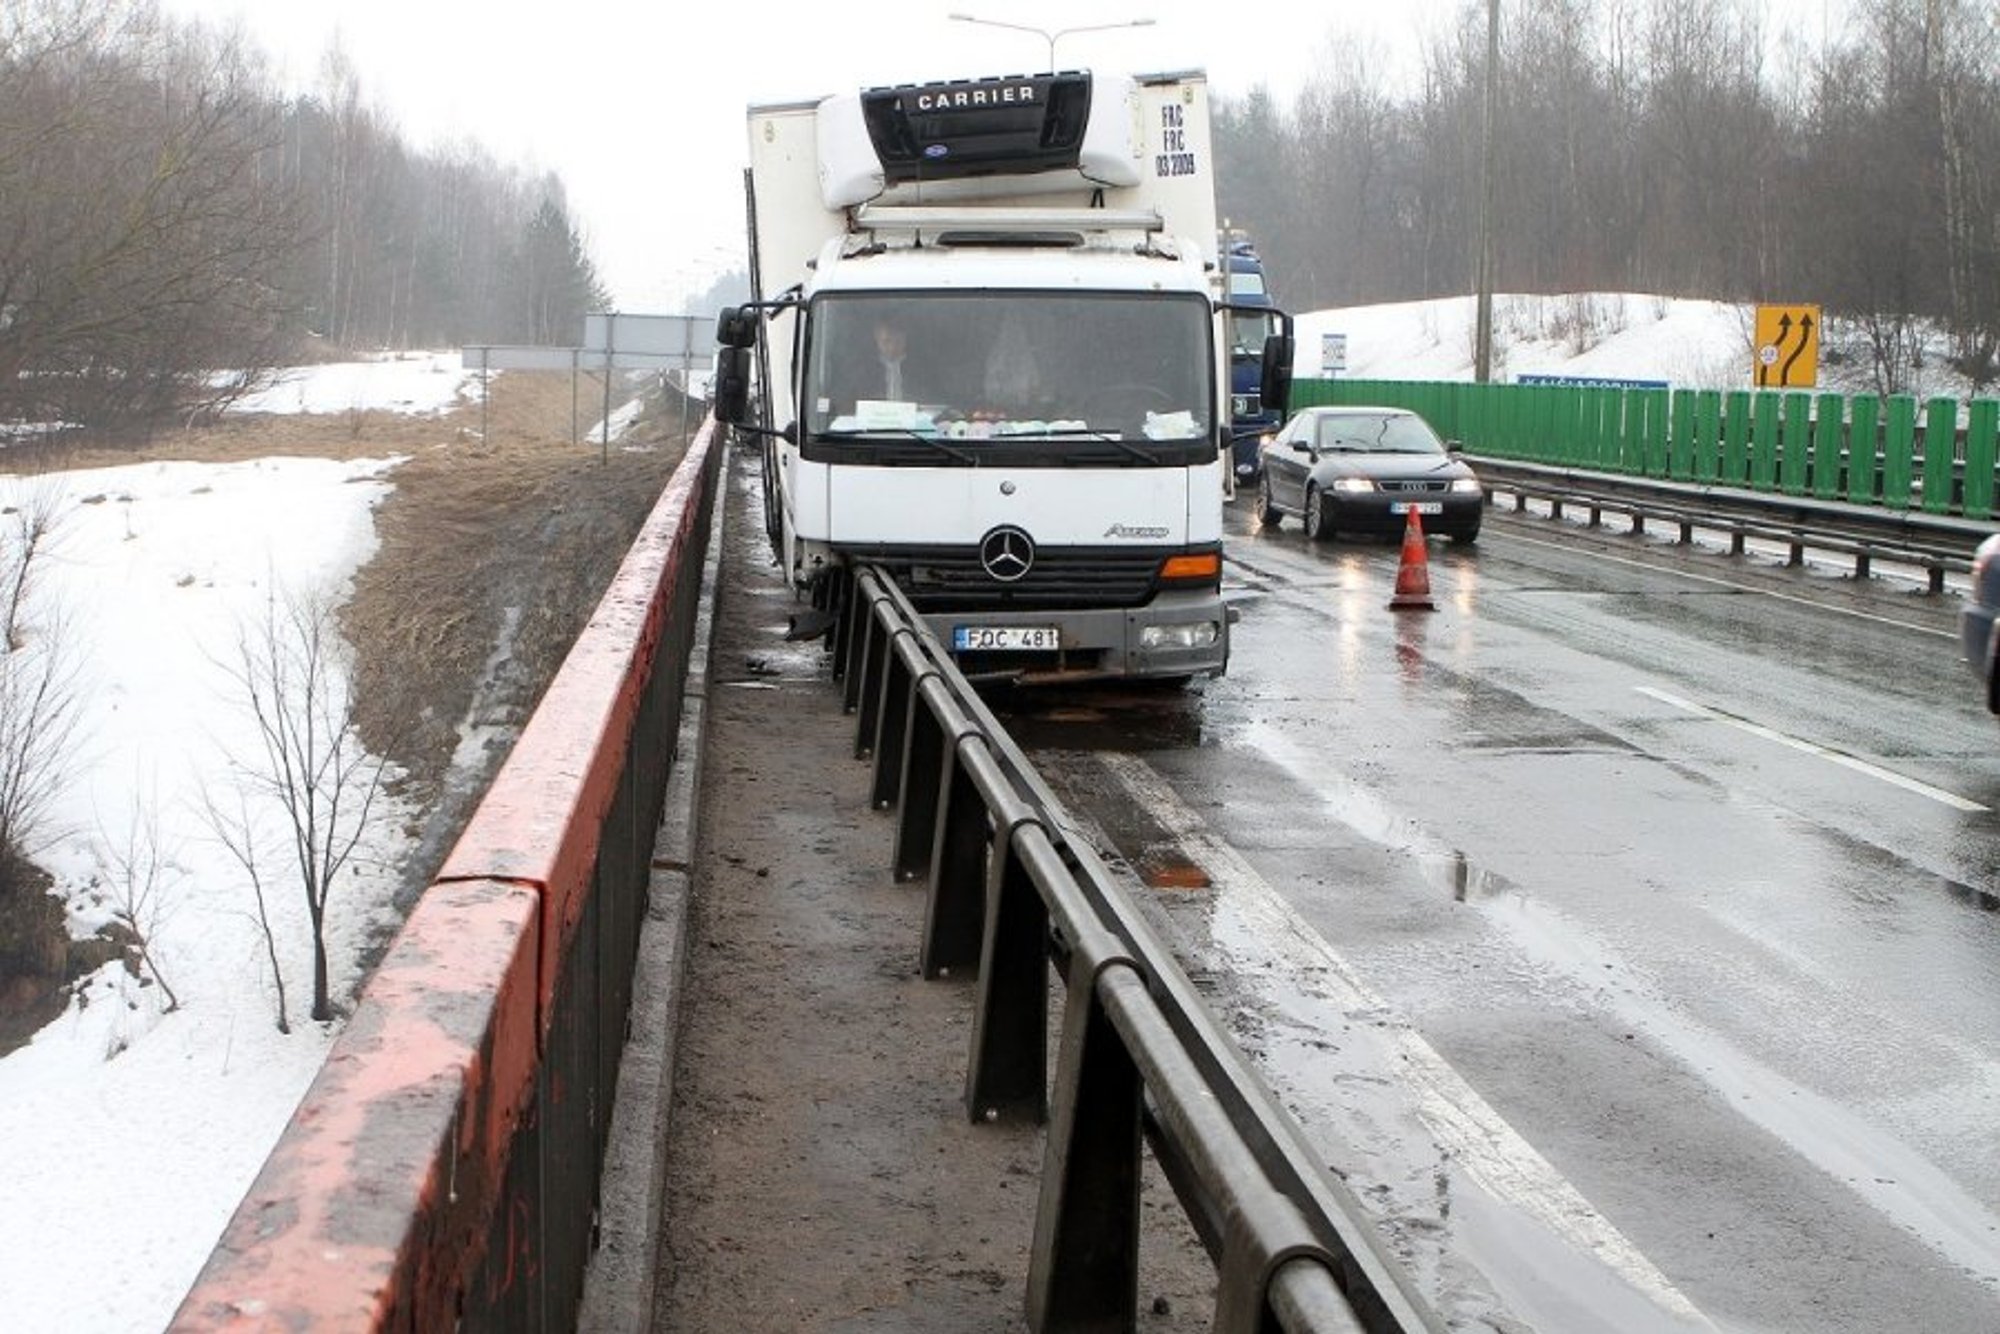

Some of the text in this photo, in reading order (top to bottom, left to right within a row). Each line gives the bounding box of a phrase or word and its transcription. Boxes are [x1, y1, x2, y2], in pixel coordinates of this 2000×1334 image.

[918, 86, 1034, 110] CARRIER
[1162, 104, 1183, 128] FRC
[1163, 129, 1185, 152] FRC
[1021, 630, 1055, 647] 481
